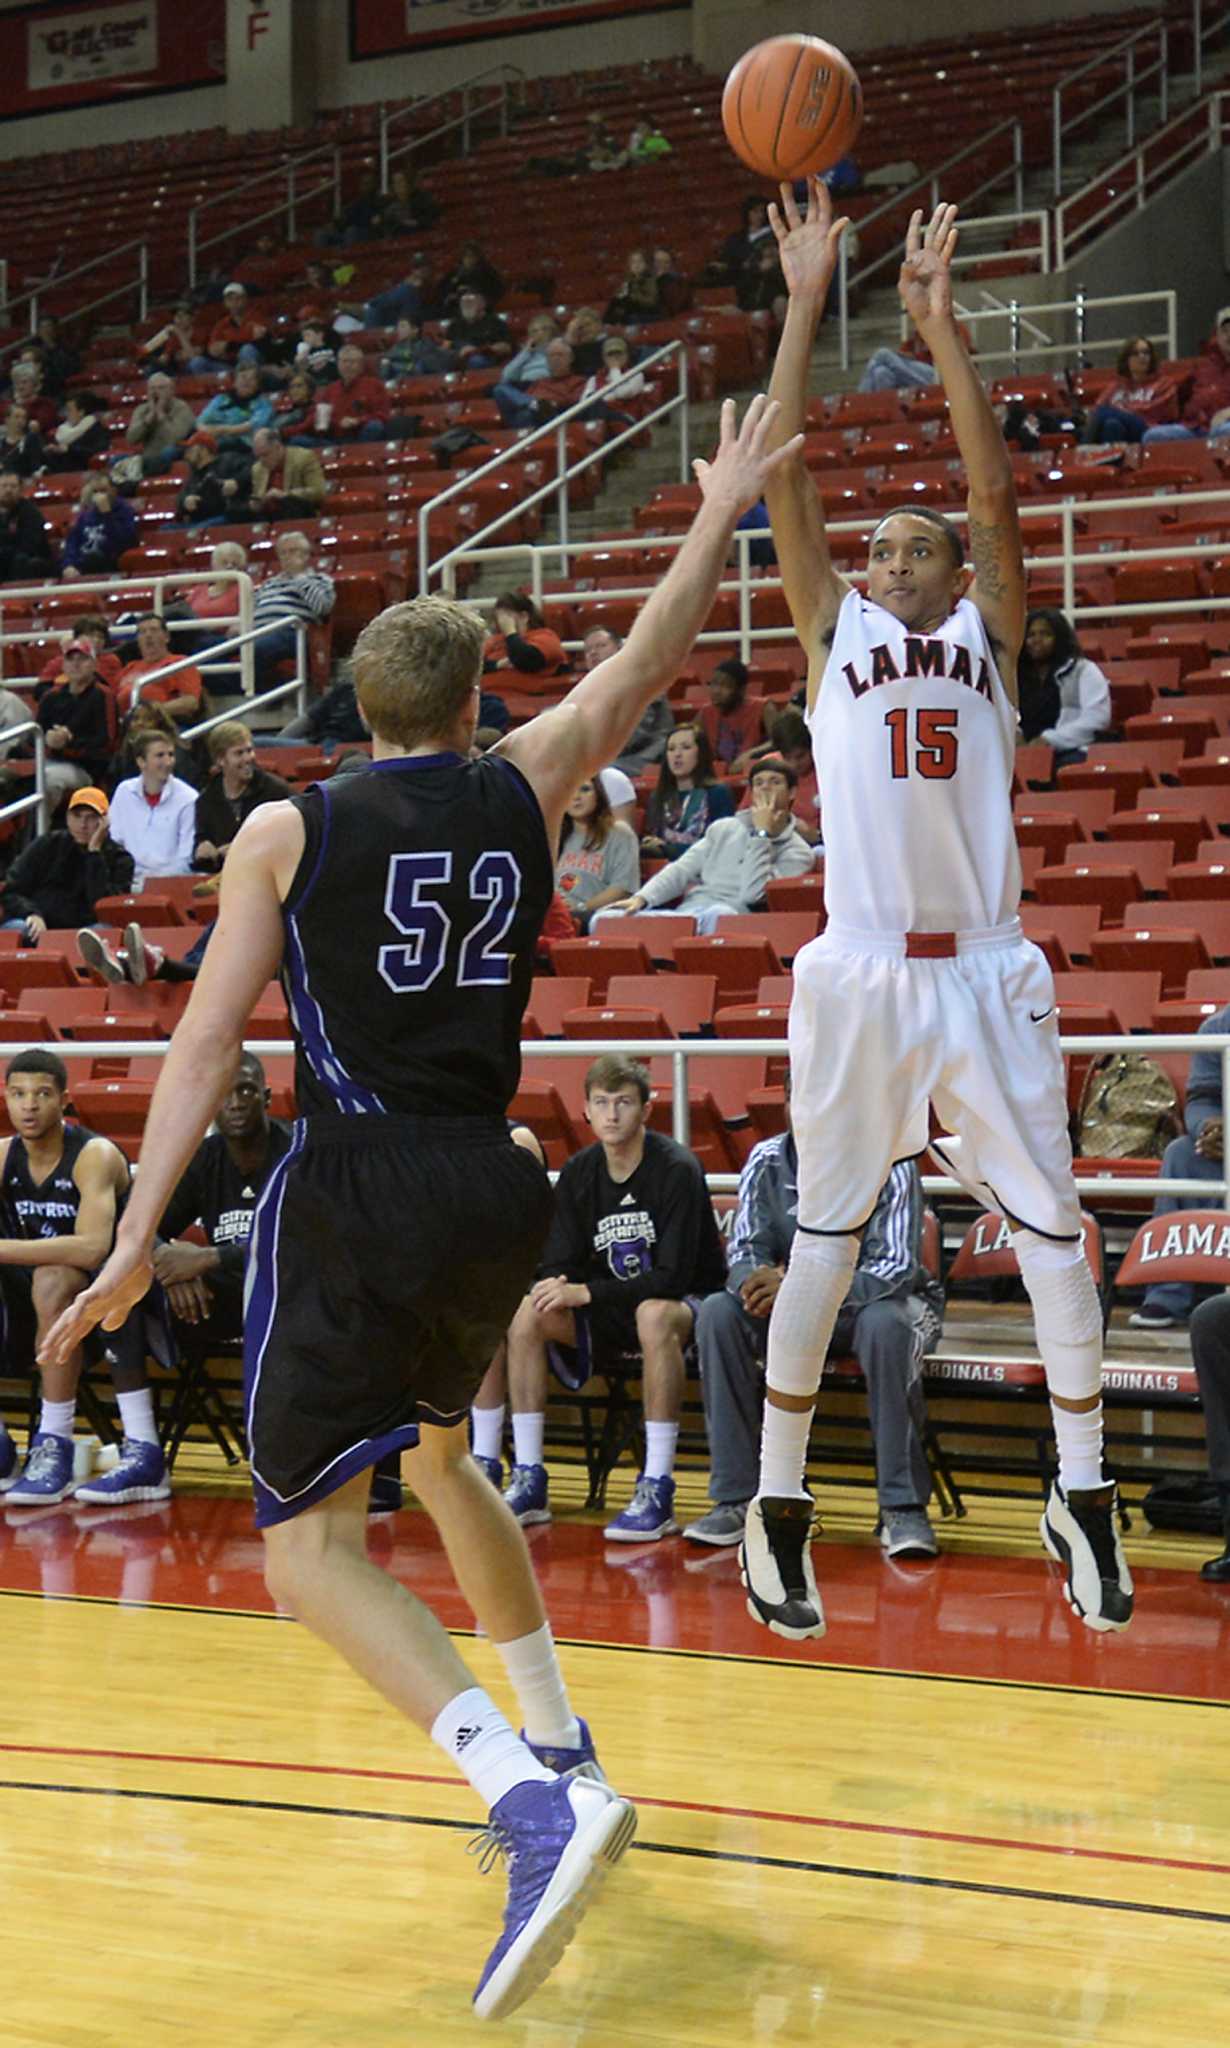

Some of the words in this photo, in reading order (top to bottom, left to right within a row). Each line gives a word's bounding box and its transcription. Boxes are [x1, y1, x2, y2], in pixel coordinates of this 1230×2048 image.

[885, 708, 959, 779] 15
[377, 851, 522, 993] 52
[1139, 1223, 1230, 1264] LAMA
[1100, 1373, 1178, 1391] RDINALS
